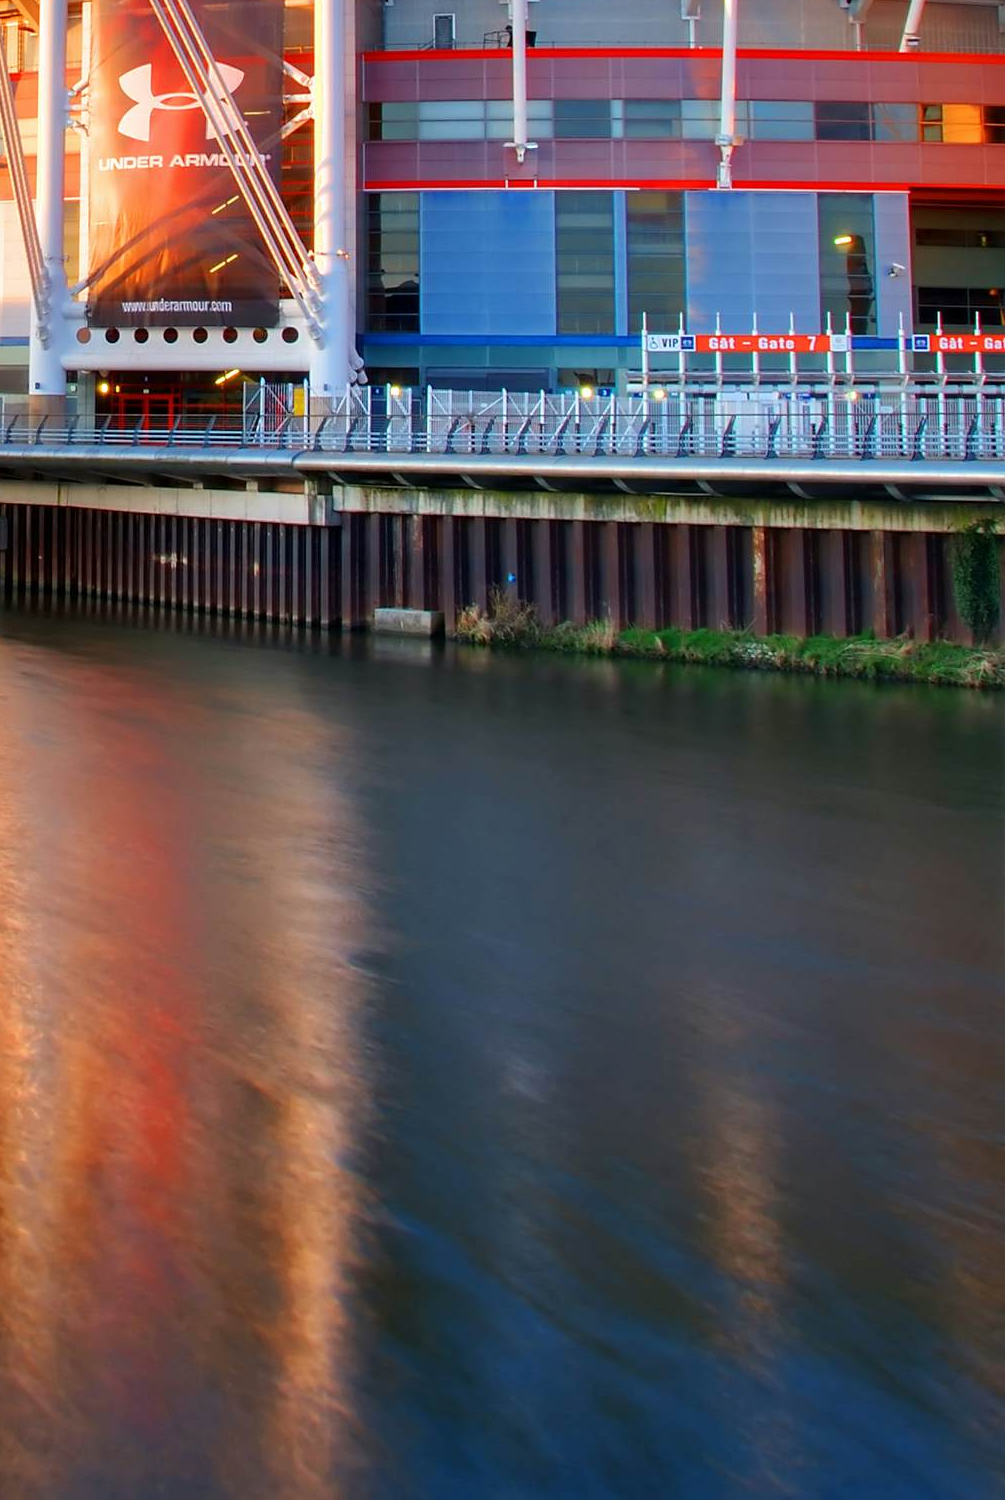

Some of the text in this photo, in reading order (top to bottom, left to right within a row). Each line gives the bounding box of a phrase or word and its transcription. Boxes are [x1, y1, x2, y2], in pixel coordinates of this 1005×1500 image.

[99, 156, 163, 171] UNDER
[122, 298, 232, 312] www.underarmour.com
[662, 338, 678, 348] VIP
[758, 337, 795, 349] Gate
[807, 336, 817, 351] 7
